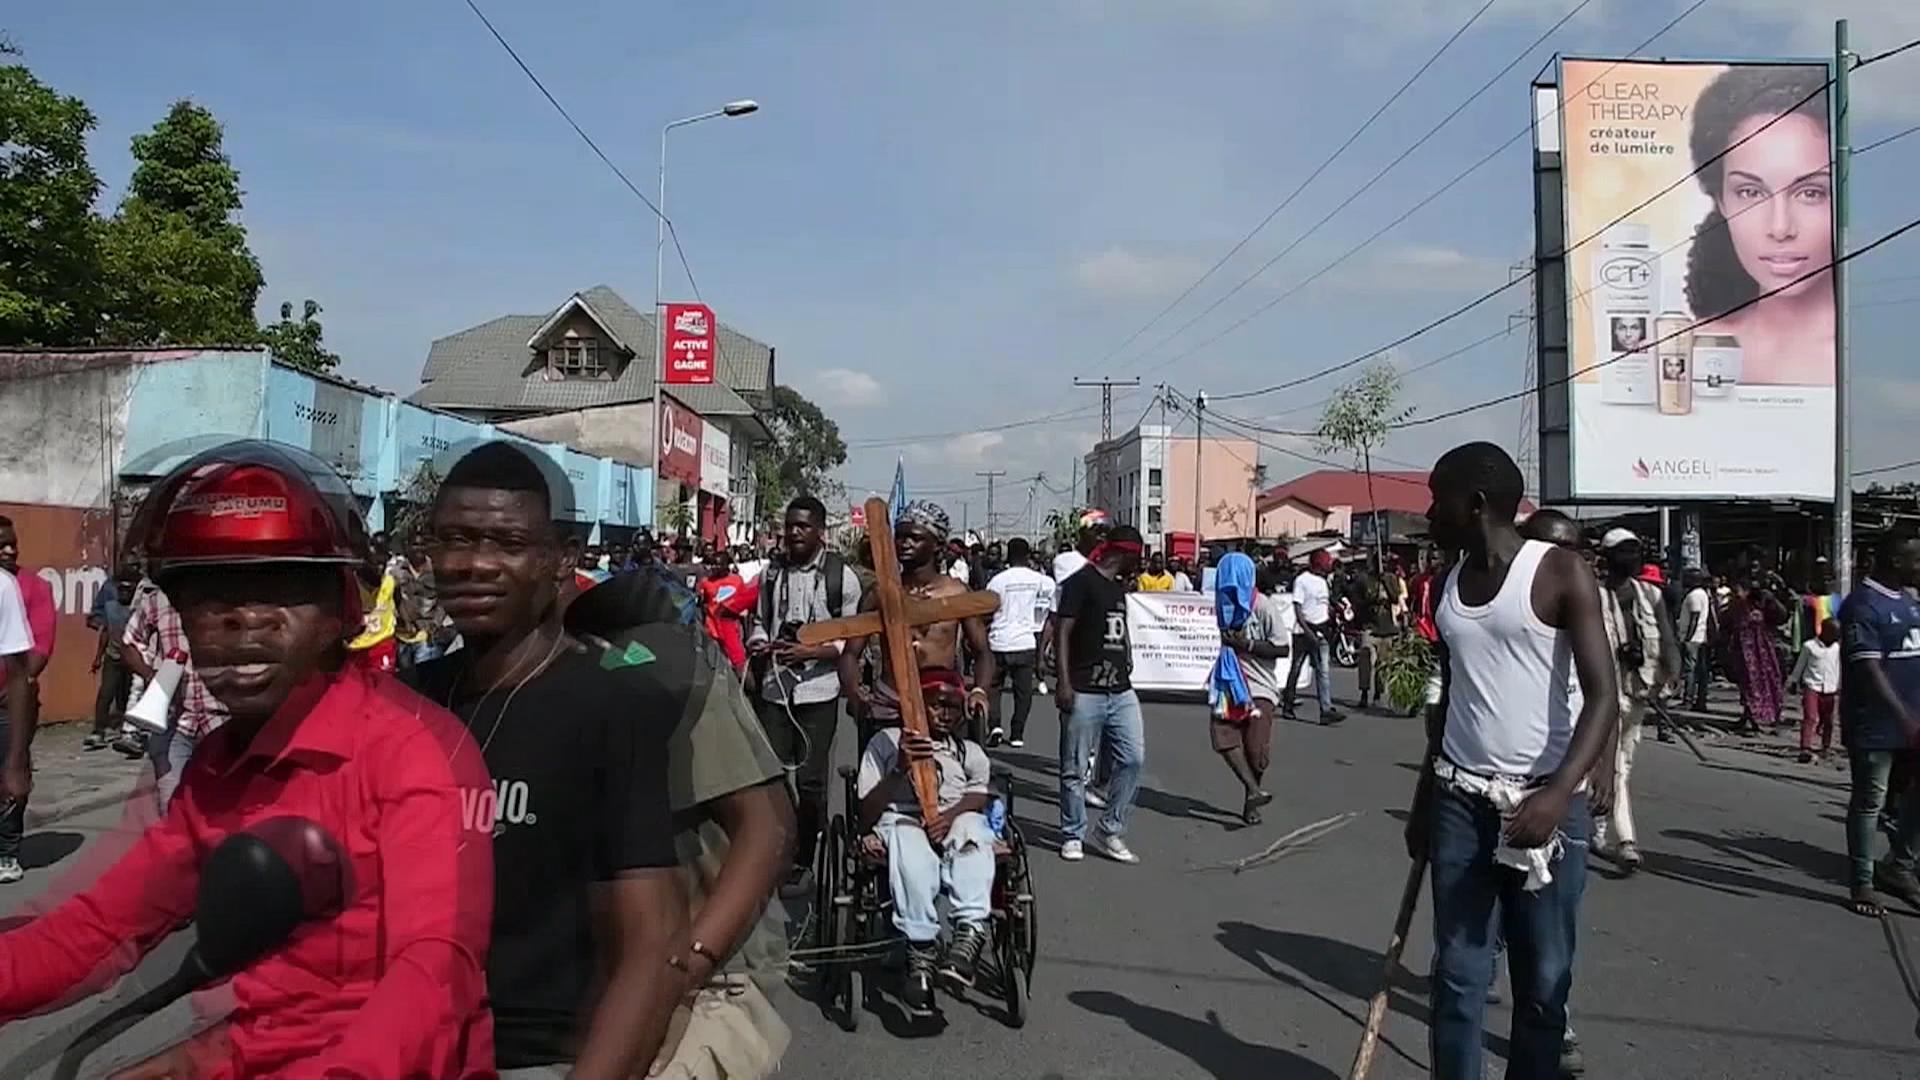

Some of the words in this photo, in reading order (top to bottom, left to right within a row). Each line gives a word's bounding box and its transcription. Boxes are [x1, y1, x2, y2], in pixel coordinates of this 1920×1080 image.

[1587, 83, 1659, 100] CLEAR
[1588, 103, 1688, 120] THERAPY
[1590, 126, 1656, 139] créateur
[1590, 142, 1609, 153] de
[1614, 142, 1674, 154] lumière
[673, 340, 708, 350] ACTIVE
[673, 360, 707, 370] GAGNE
[1651, 459, 1711, 474] ANGEL
[1164, 605, 1195, 615] TROP
